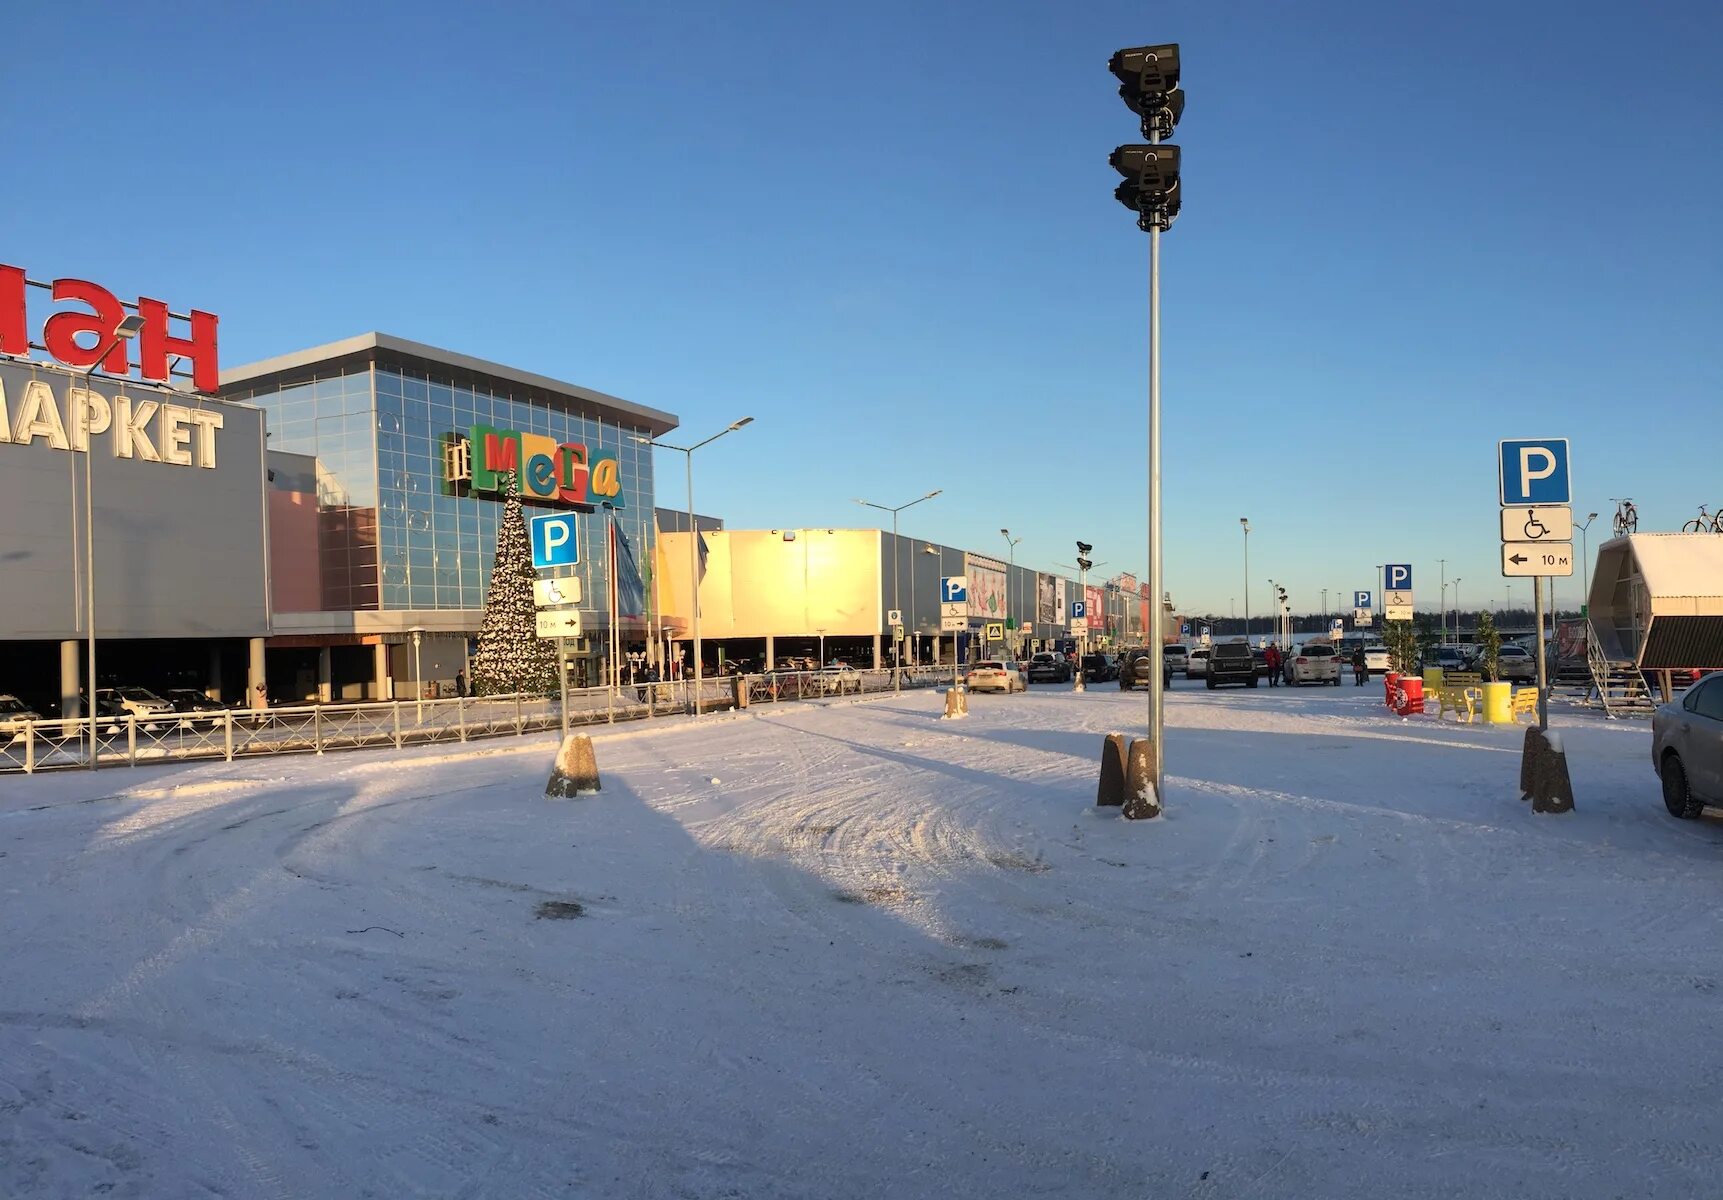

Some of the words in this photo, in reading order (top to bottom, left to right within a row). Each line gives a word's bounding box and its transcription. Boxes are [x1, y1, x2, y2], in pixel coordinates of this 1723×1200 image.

[0, 264, 219, 394] ан
[0, 376, 224, 469] АРКЕТ
[1519, 446, 1557, 498] P
[543, 519, 570, 562] P
[1541, 554, 1555, 566] 10
[1391, 566, 1408, 588] P
[948, 580, 963, 601] P
[1358, 592, 1369, 606] P
[1074, 603, 1083, 617] P
[539, 620, 548, 629] 10
[1182, 625, 1189, 633] P
